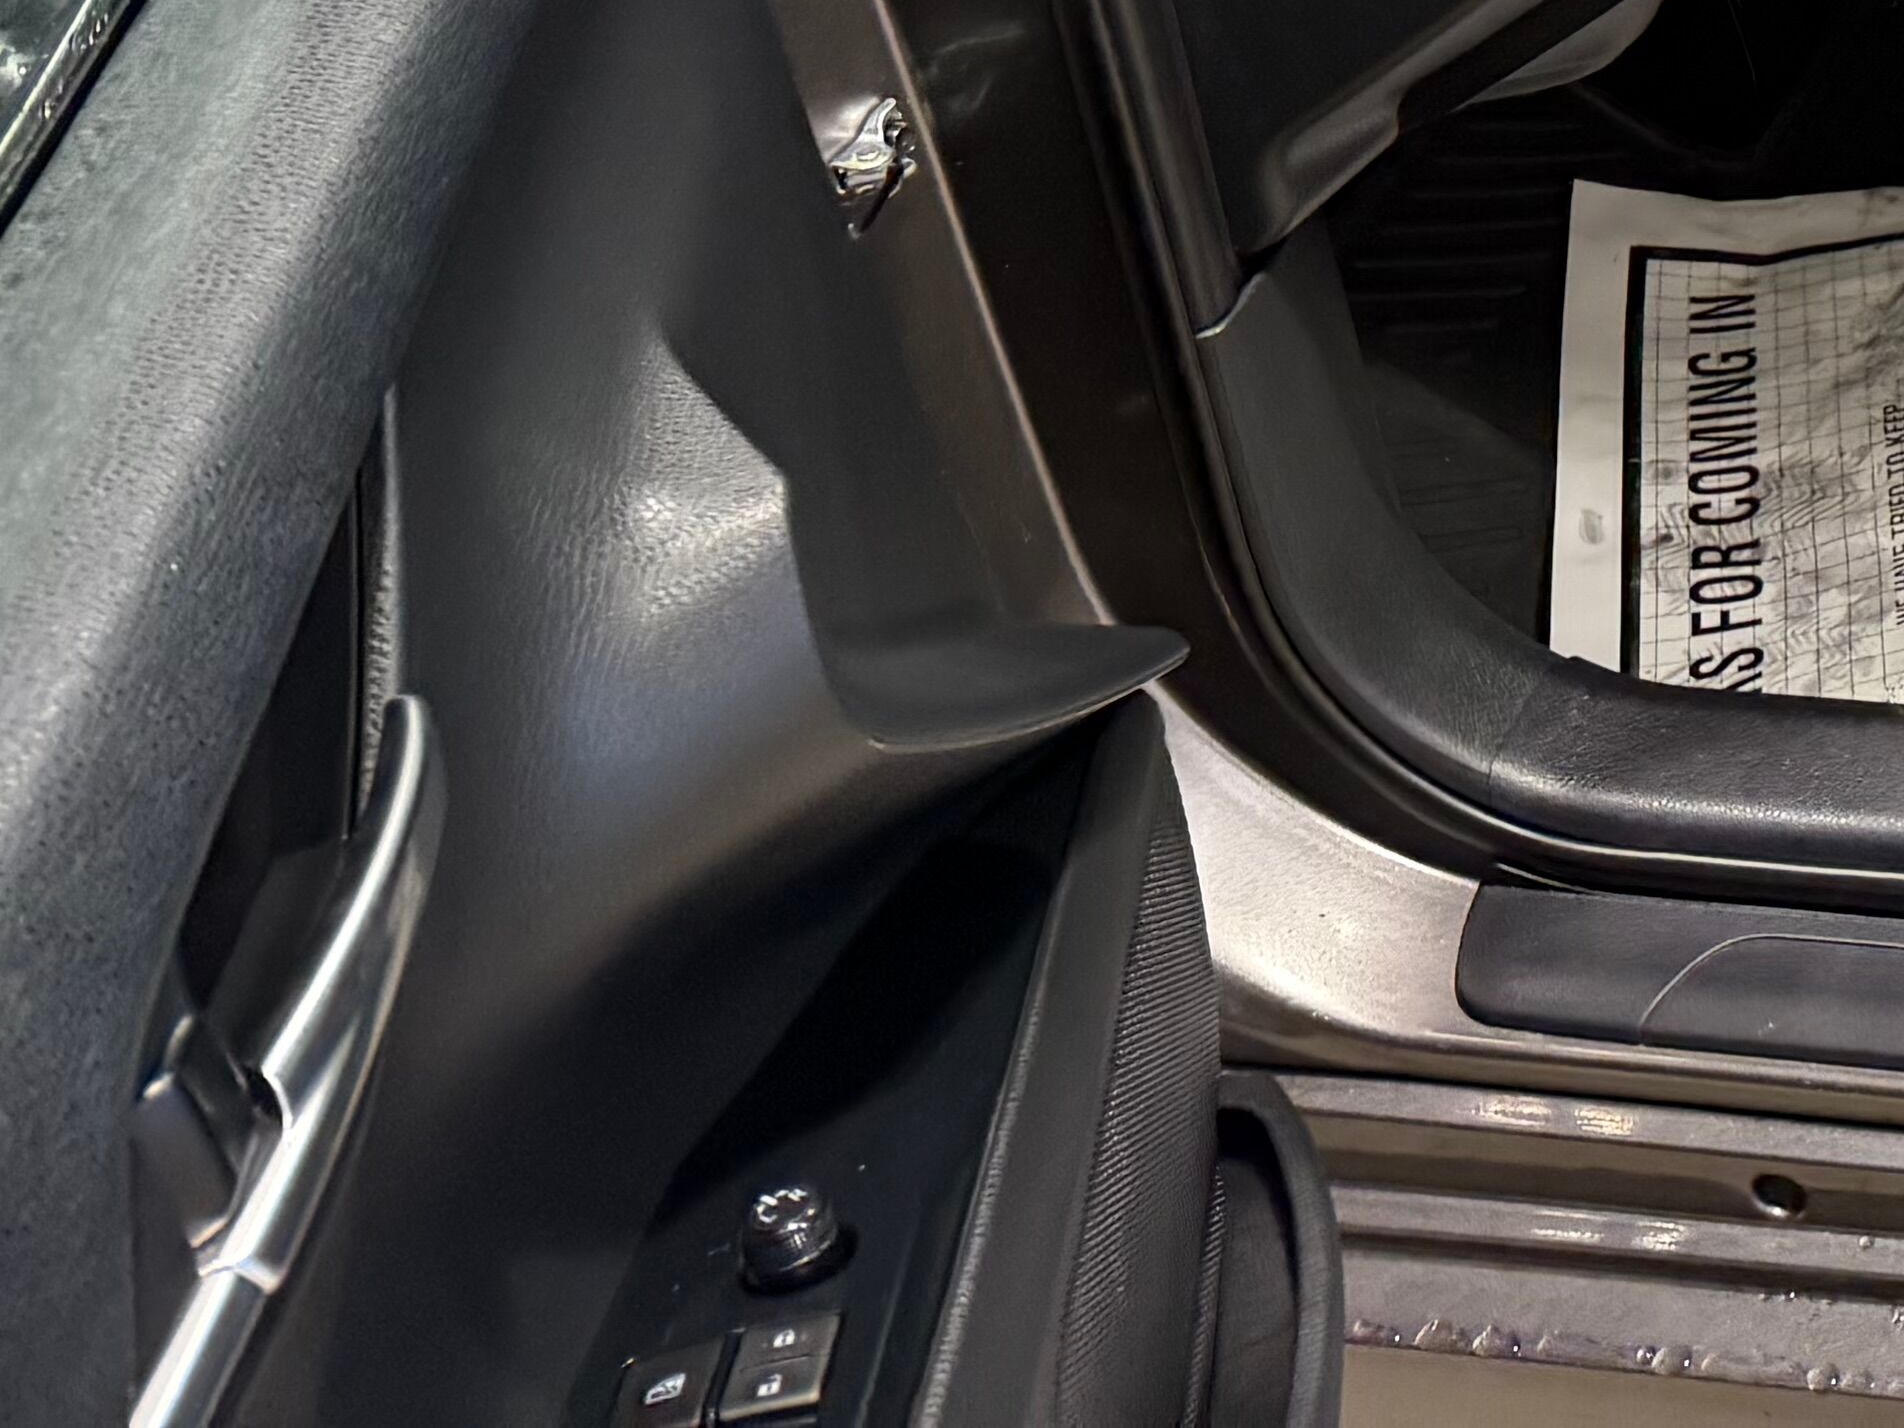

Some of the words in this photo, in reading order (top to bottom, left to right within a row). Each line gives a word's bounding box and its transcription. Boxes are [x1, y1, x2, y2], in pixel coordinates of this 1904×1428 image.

[1690, 294, 1756, 334] IN
[1688, 347, 1761, 526] COMING
[1690, 538, 1763, 636] FOR
